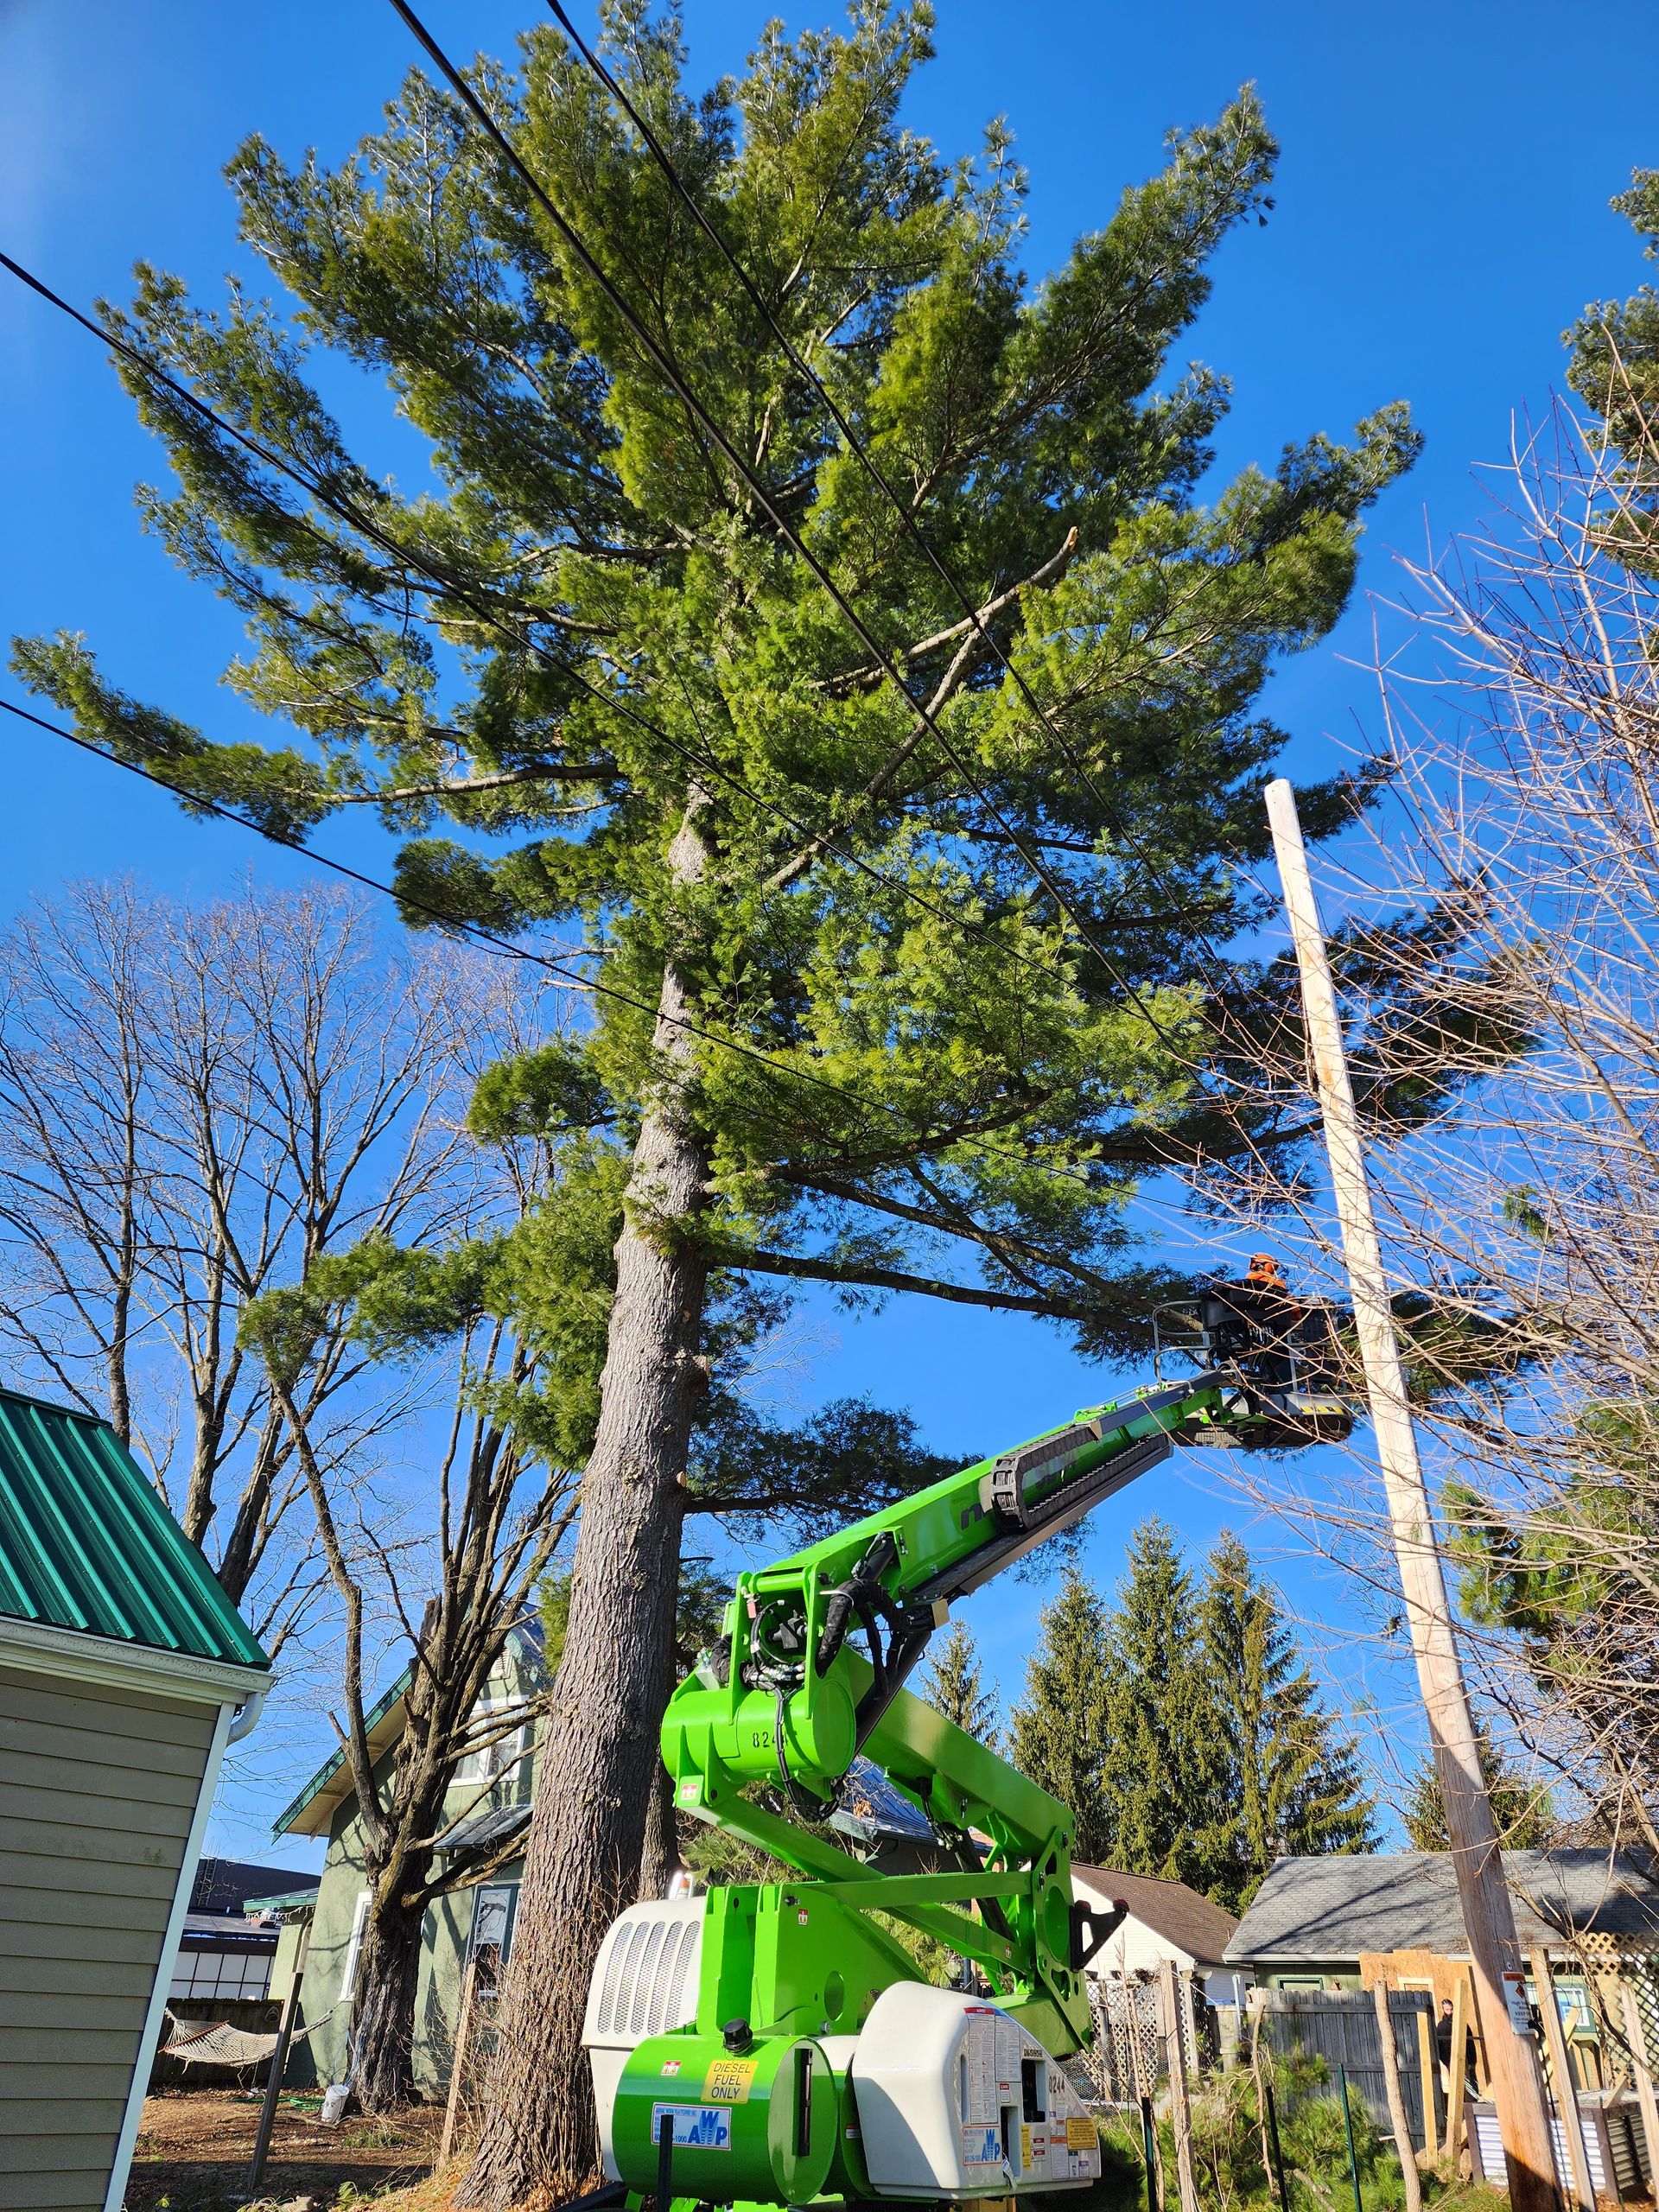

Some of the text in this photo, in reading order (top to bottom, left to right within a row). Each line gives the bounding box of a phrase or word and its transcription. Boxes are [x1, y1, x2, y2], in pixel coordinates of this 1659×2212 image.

[713, 2063, 751, 2074] DIESEL
[714, 2074, 742, 2086] FUEL
[1048, 2075, 1065, 2094] 8244
[711, 2086, 741, 2100] ONLY
[687, 2110, 728, 2146] AWP
